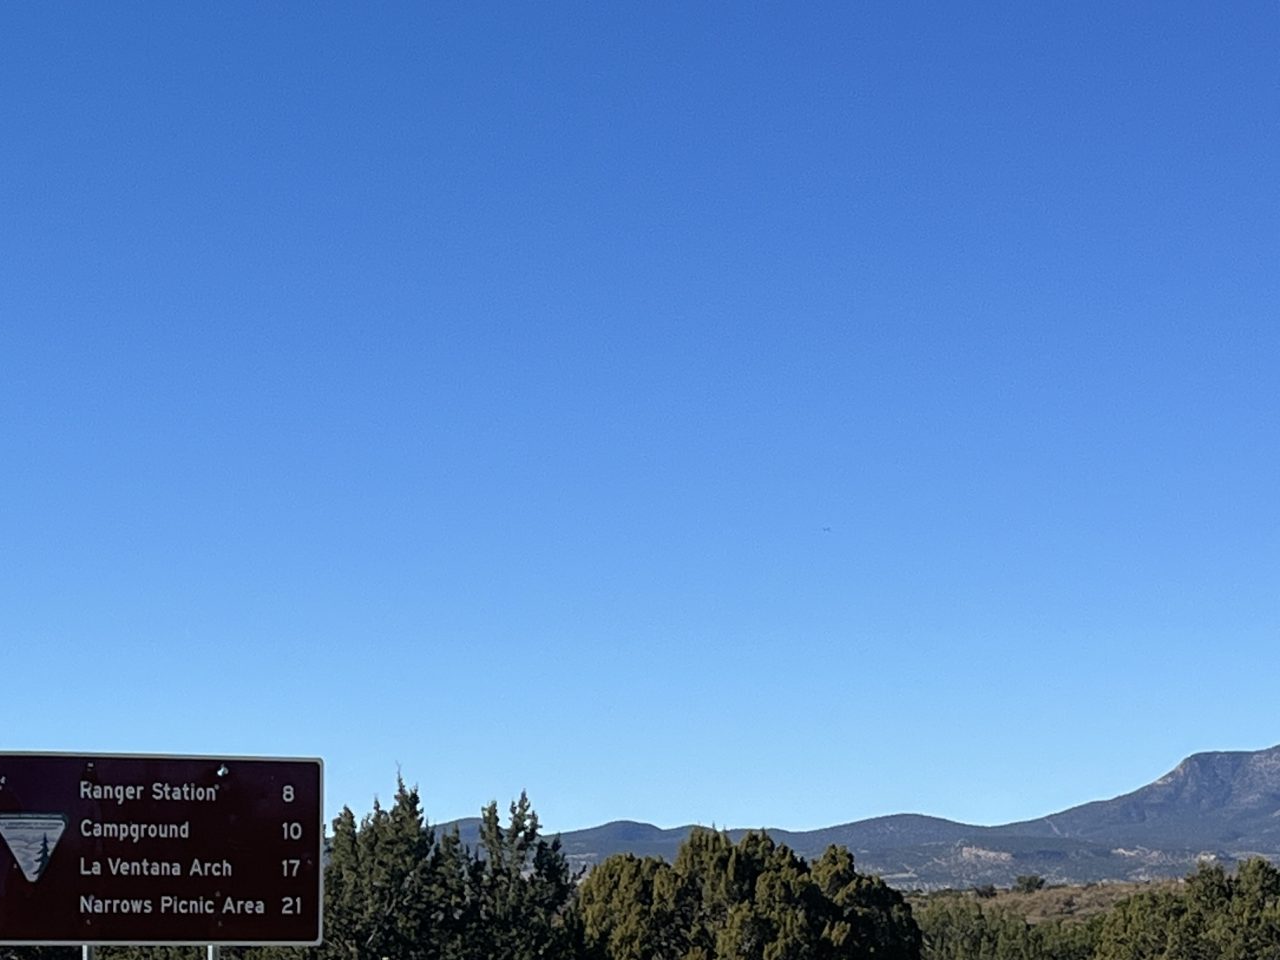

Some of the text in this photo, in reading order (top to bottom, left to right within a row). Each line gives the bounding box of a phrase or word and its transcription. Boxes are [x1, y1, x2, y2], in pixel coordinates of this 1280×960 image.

[80, 781, 295, 805] Ranger Station 8
[80, 819, 302, 843] Campground 10
[80, 857, 300, 877] La Ventana Arch 17
[80, 896, 301, 914] Narrows Picnic Area 21
